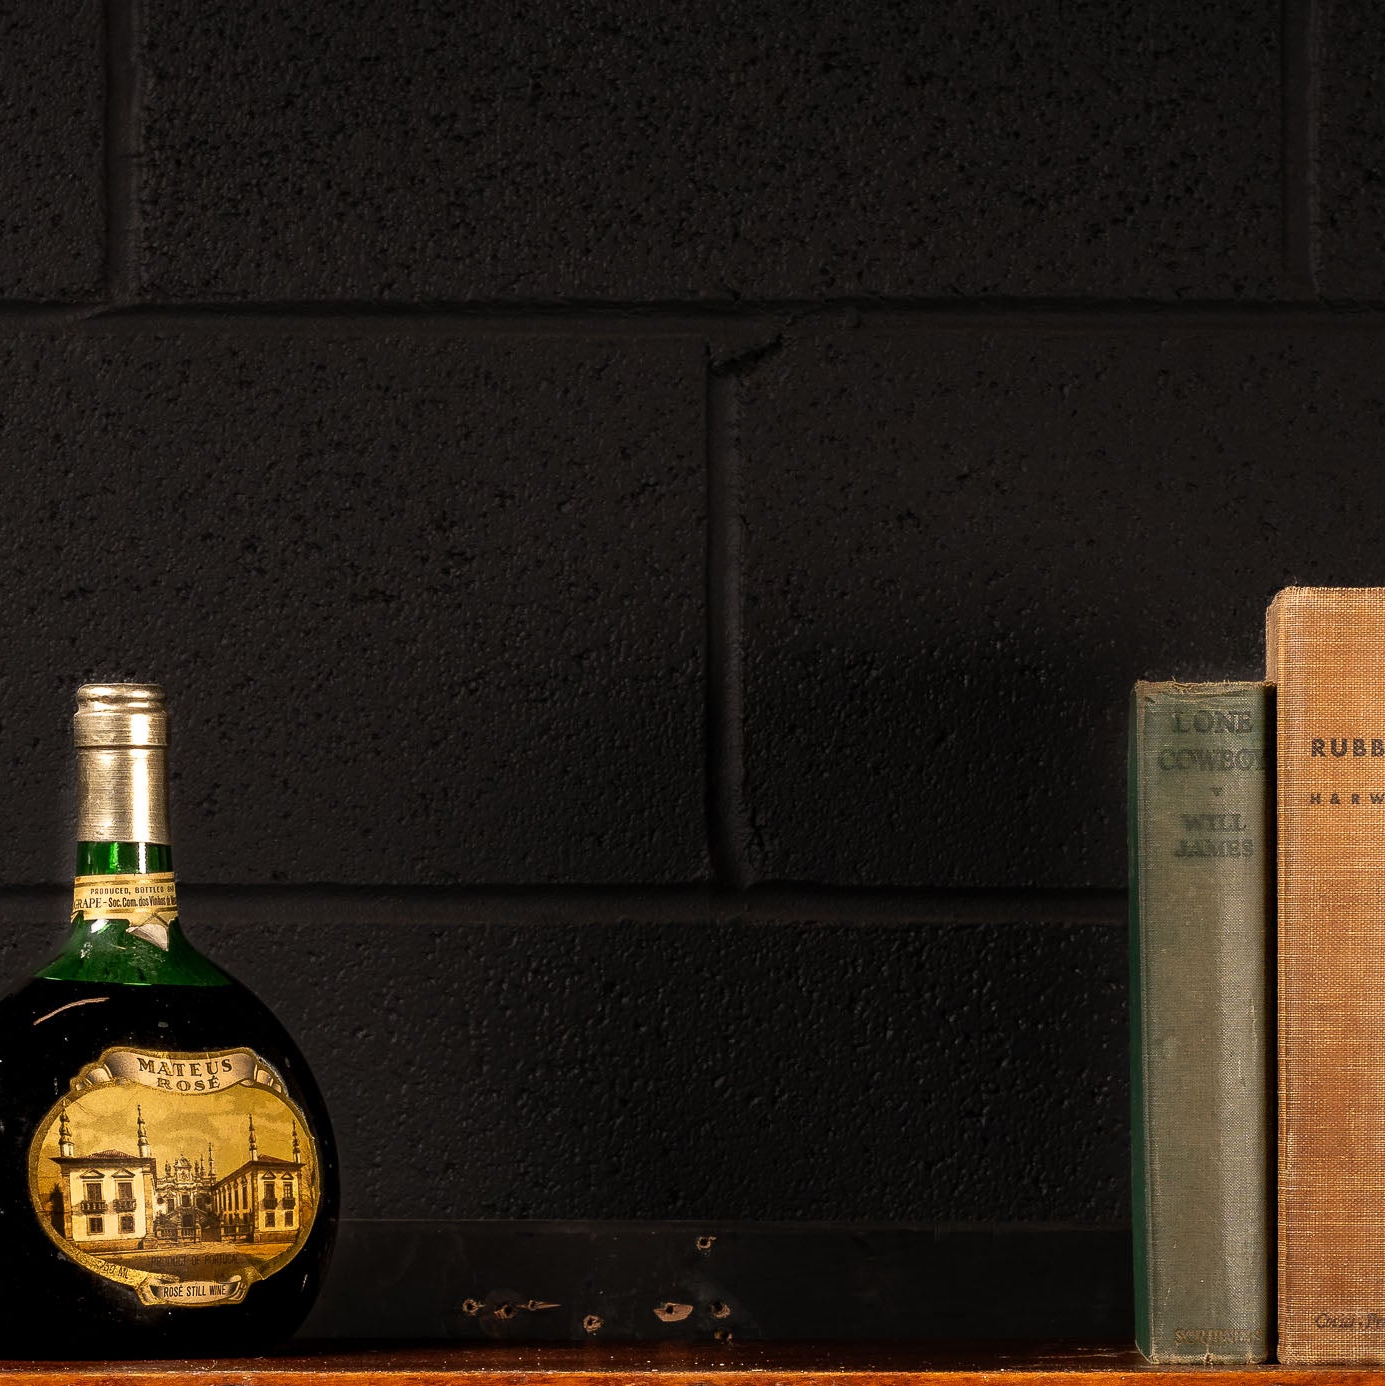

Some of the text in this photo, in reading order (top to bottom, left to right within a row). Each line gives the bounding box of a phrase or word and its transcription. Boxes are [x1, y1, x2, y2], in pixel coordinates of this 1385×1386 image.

[1172, 710, 1253, 733] LONE
[1310, 793, 1321, 805] H
[1330, 793, 1341, 805] &
[1351, 793, 1361, 805] R
[1180, 813, 1247, 832] WILL
[1174, 839, 1254, 858] JAMES
[90, 887, 132, 895] PRODUCED,
[136, 1057, 233, 1077] MATEUS
[157, 1075, 221, 1091] ROSÉ
[164, 1284, 226, 1298] ROSÉ STILL WINE
